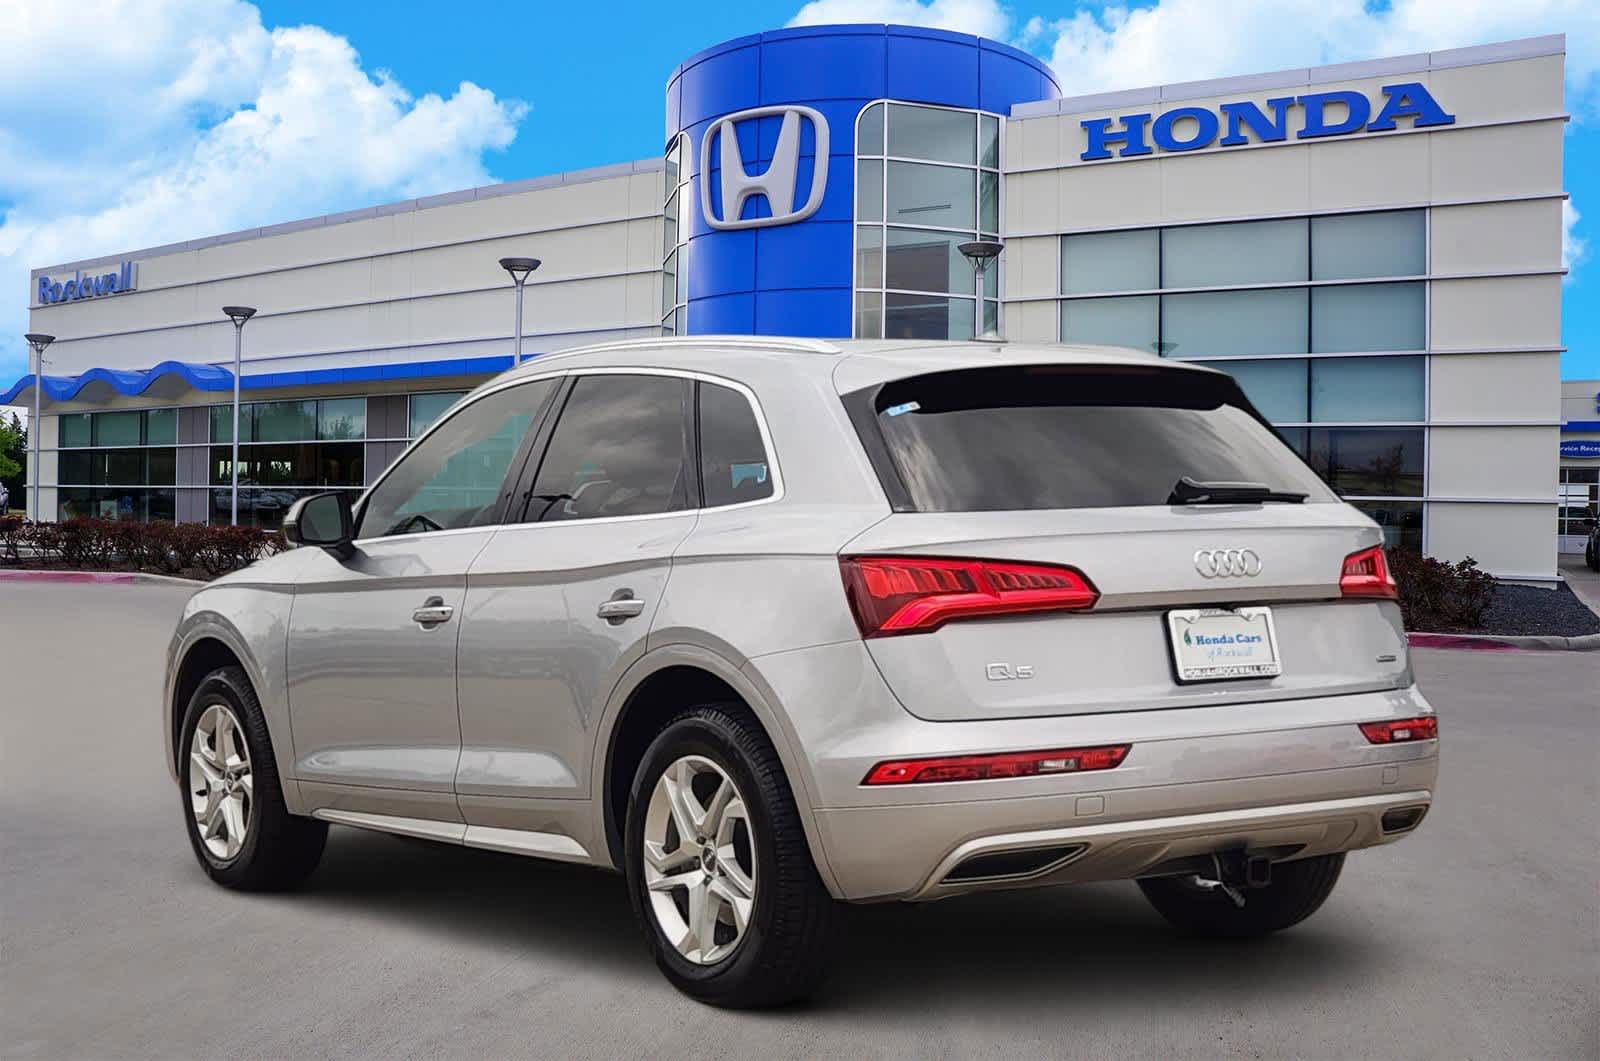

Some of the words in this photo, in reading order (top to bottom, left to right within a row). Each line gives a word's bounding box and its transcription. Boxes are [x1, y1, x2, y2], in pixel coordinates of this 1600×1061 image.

[1080, 82, 1456, 160] HONDA
[1195, 634, 1235, 646] Honda
[1236, 633, 1263, 643] Cars
